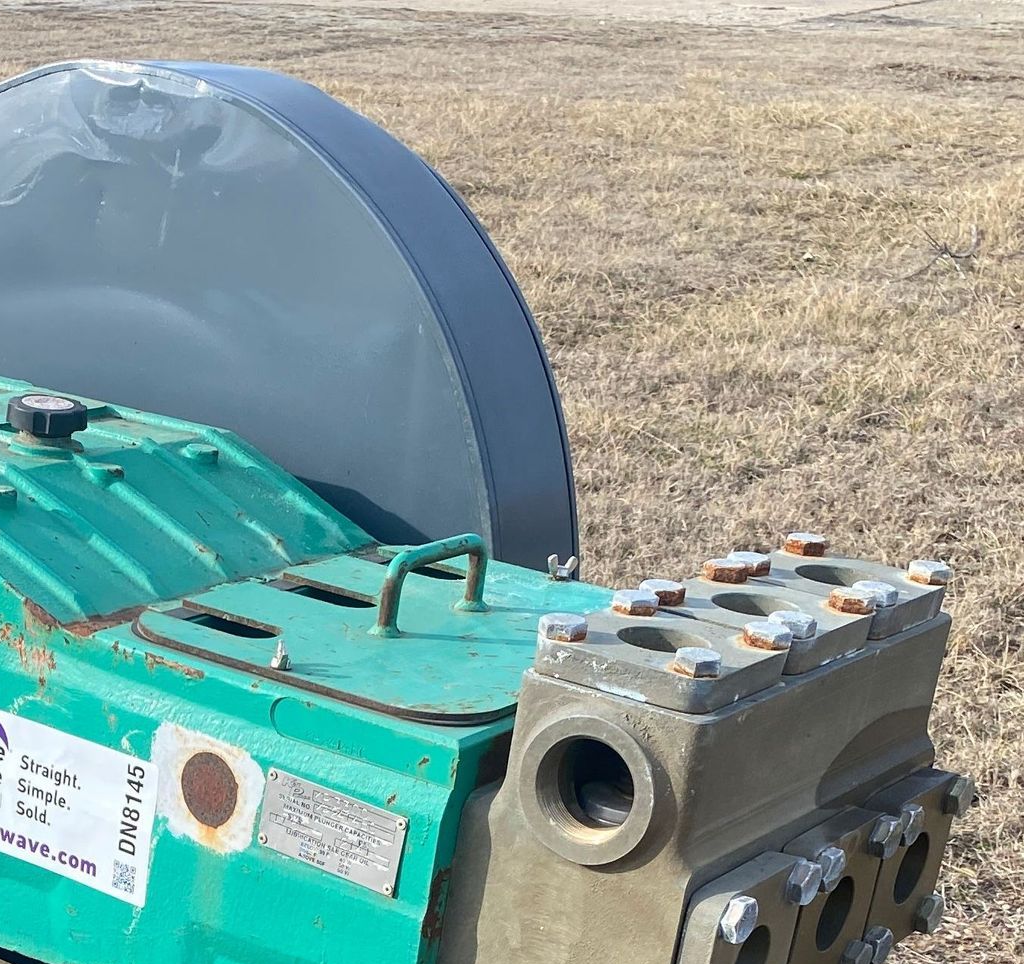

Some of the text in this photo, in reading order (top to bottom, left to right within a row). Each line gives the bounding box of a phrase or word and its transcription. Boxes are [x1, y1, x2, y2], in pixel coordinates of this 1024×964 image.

[20, 755, 82, 790] Straight.
[17, 778, 71, 810] Simple.
[119, 763, 145, 856] DN8145
[16, 801, 51, 826] Sold.
[314, 815, 343, 832] PLUNGER
